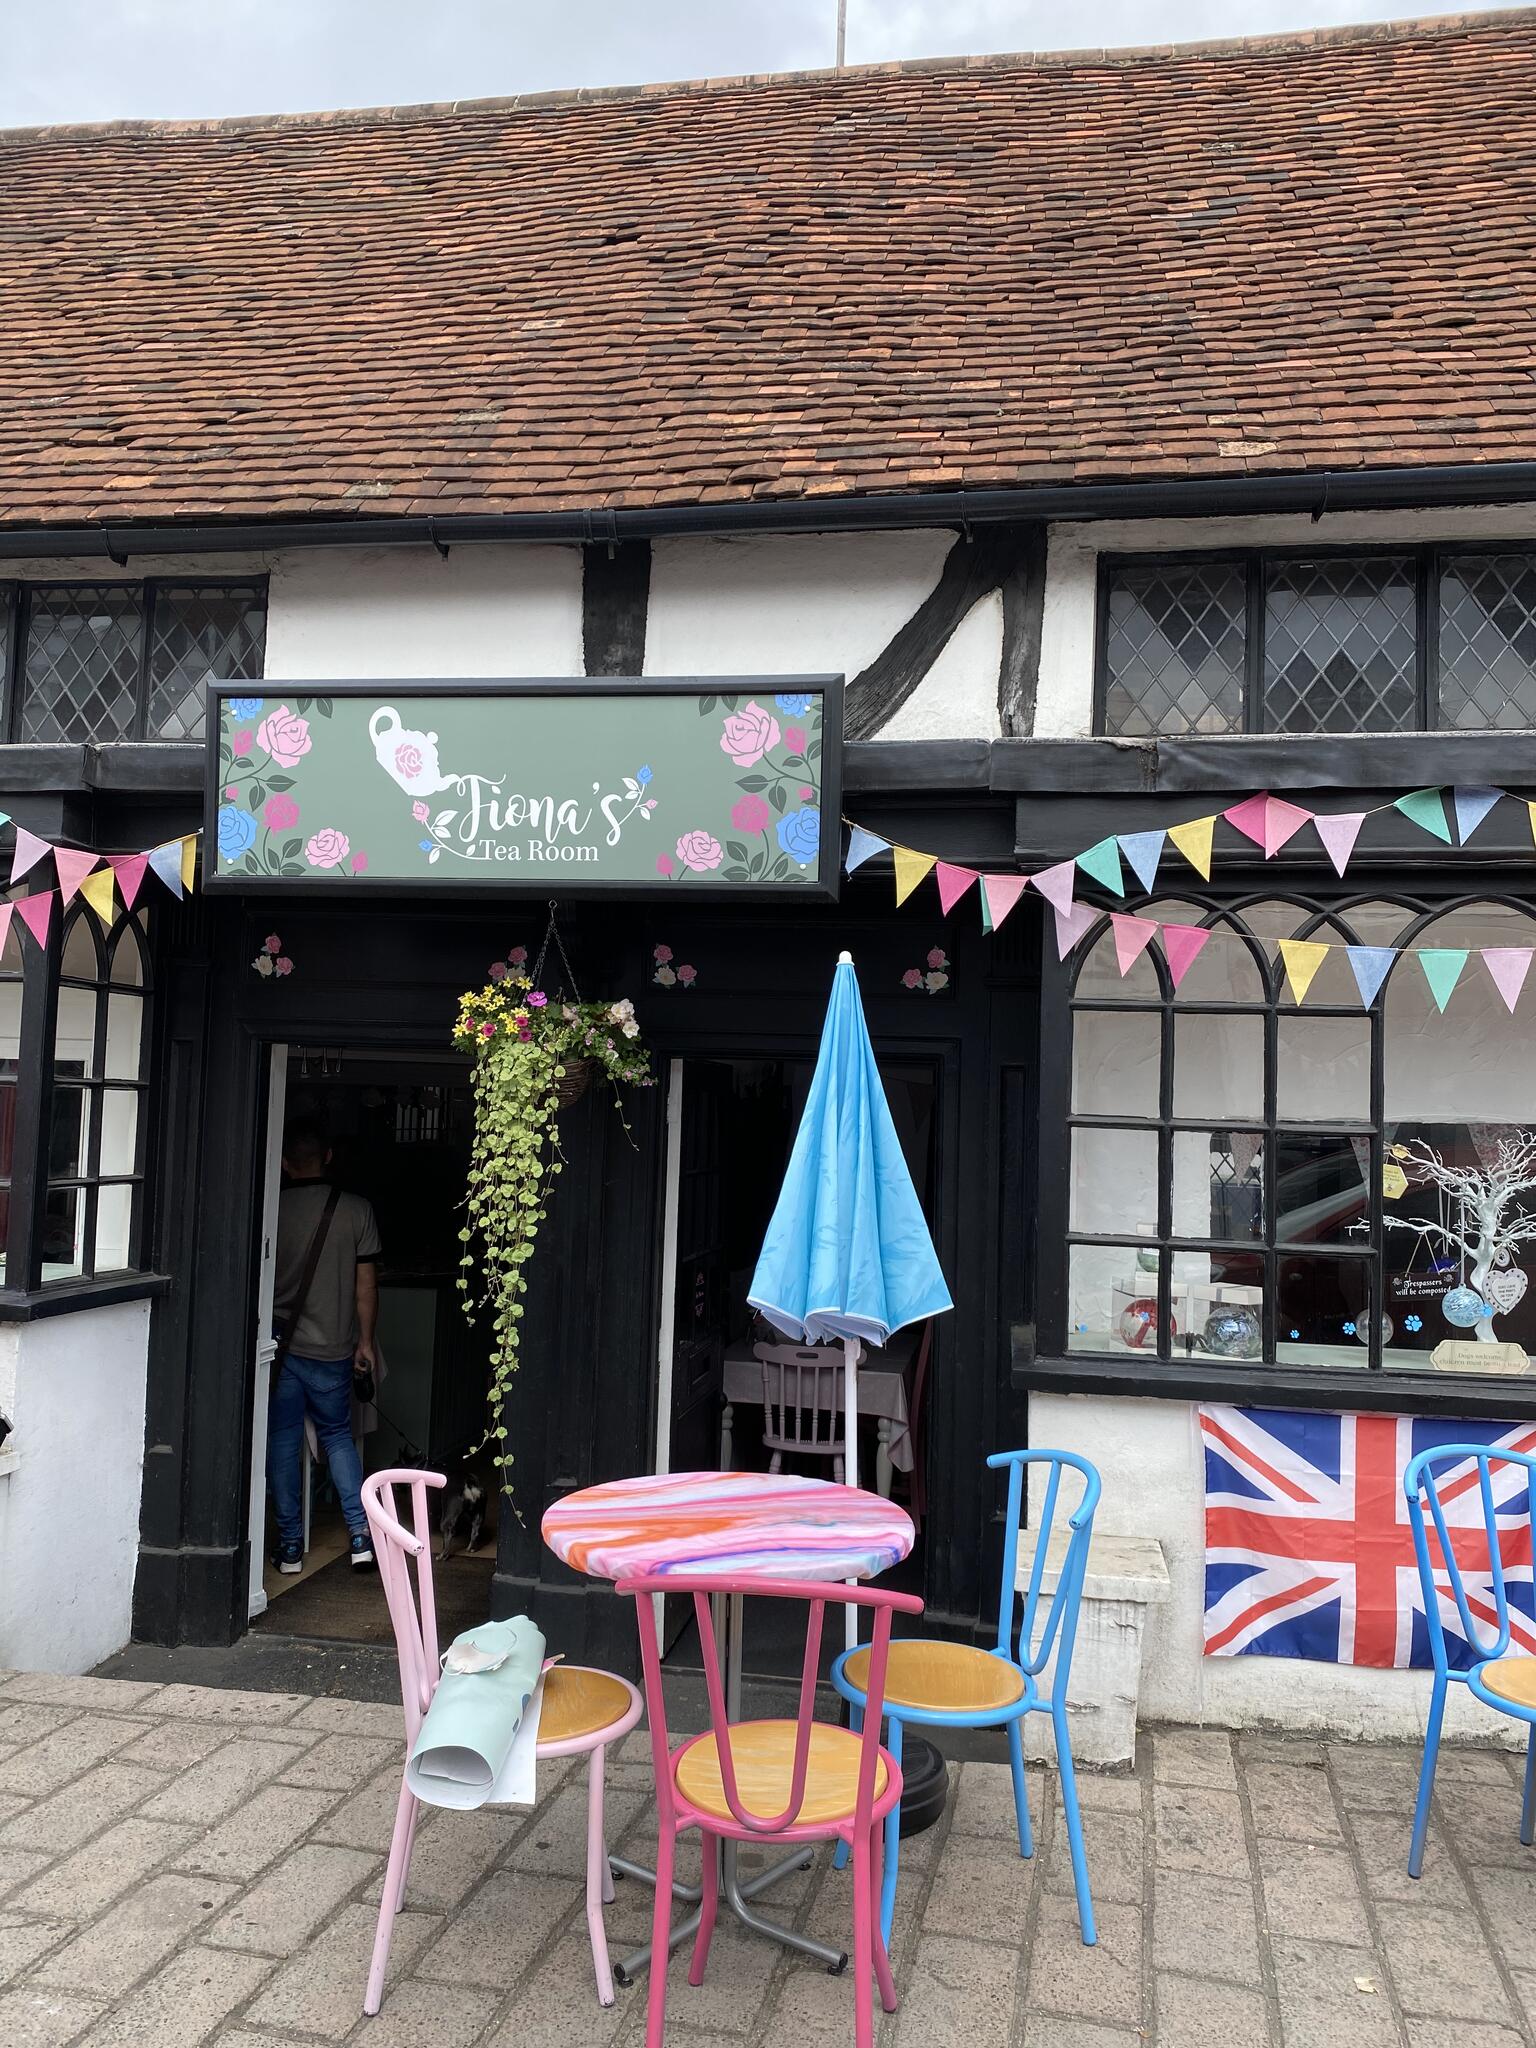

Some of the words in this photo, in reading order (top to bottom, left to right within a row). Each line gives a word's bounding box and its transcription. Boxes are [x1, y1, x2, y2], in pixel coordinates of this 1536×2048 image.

[458, 774, 623, 846] Fiona's
[479, 839, 522, 861] Tea
[527, 839, 600, 861] Room
[1395, 1288, 1408, 1296] will
[1410, 1287, 1417, 1295] be
[1403, 1279, 1443, 1289] Trespassers
